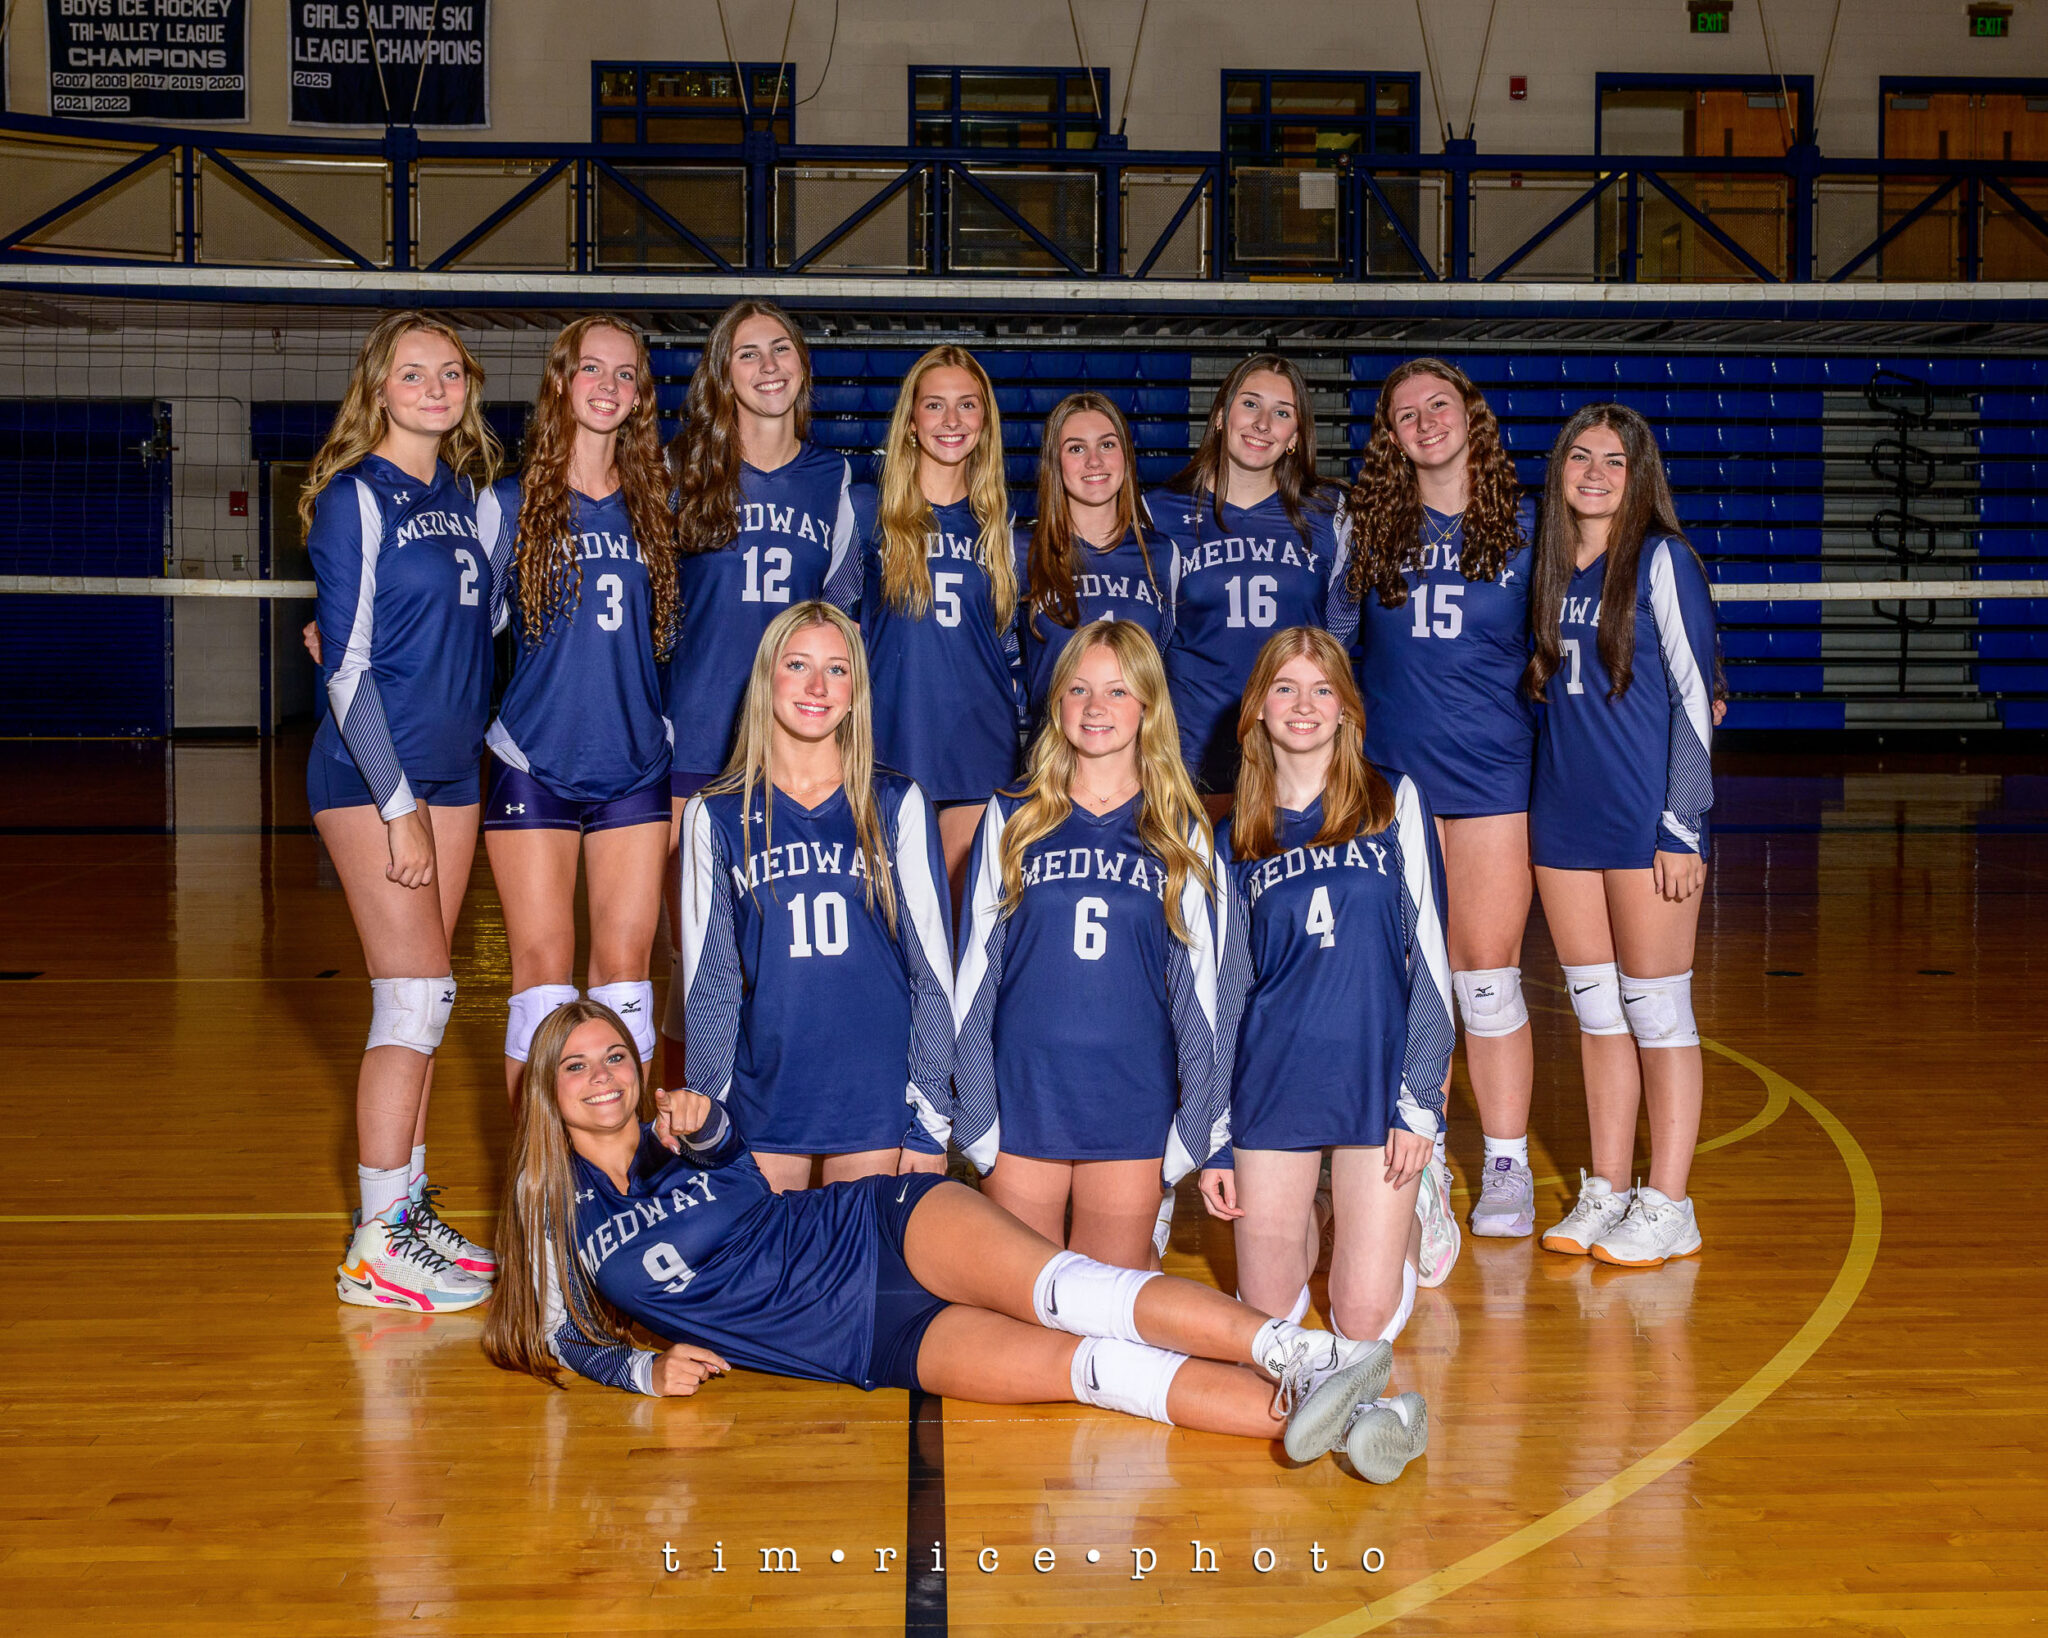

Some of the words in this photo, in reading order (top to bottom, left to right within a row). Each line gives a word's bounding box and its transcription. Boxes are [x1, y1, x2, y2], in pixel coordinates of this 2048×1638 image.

[60, 0, 112, 16] BOYS
[118, 0, 148, 16] ICE
[154, 0, 232, 17] HOCKEY
[69, 23, 159, 41] TRI-VALLEY
[166, 24, 226, 42] LEAGUE
[303, 4, 359, 29] GIRLS
[366, 5, 435, 30] ALPINE
[442, 7, 473, 31] SKI
[1697, 13, 1723, 32] EXIT
[1977, 17, 2003, 36] EXIT
[68, 48, 227, 68] CHAMPIONS
[295, 37, 370, 63] LEAGUE
[376, 39, 482, 64] CHAMPIONS
[55, 74, 87, 87] 2007
[95, 74, 127, 87] 2008
[133, 75, 166, 88] 2017
[171, 77, 204, 89] 2019
[209, 77, 242, 89] 2020
[56, 97, 88, 109] 2021
[94, 97, 128, 109] 2022
[295, 73, 330, 86] 2025
[397, 511, 479, 548] MEDWA
[736, 503, 831, 551] DWAY
[454, 548, 479, 606] 2
[742, 546, 793, 603] 12
[1181, 537, 1319, 578] MEDWAY
[596, 574, 623, 631] 3
[935, 572, 963, 627] 5
[1225, 575, 1278, 628] 16
[1411, 584, 1464, 639] 15
[1559, 639, 1584, 694] 7
[1249, 839, 1387, 909] MEDWAY
[787, 892, 849, 957] 10
[1074, 896, 1109, 960] 6
[1305, 885, 1336, 949] 4
[579, 1172, 717, 1287] MEDWAY
[642, 1242, 696, 1293] 9
